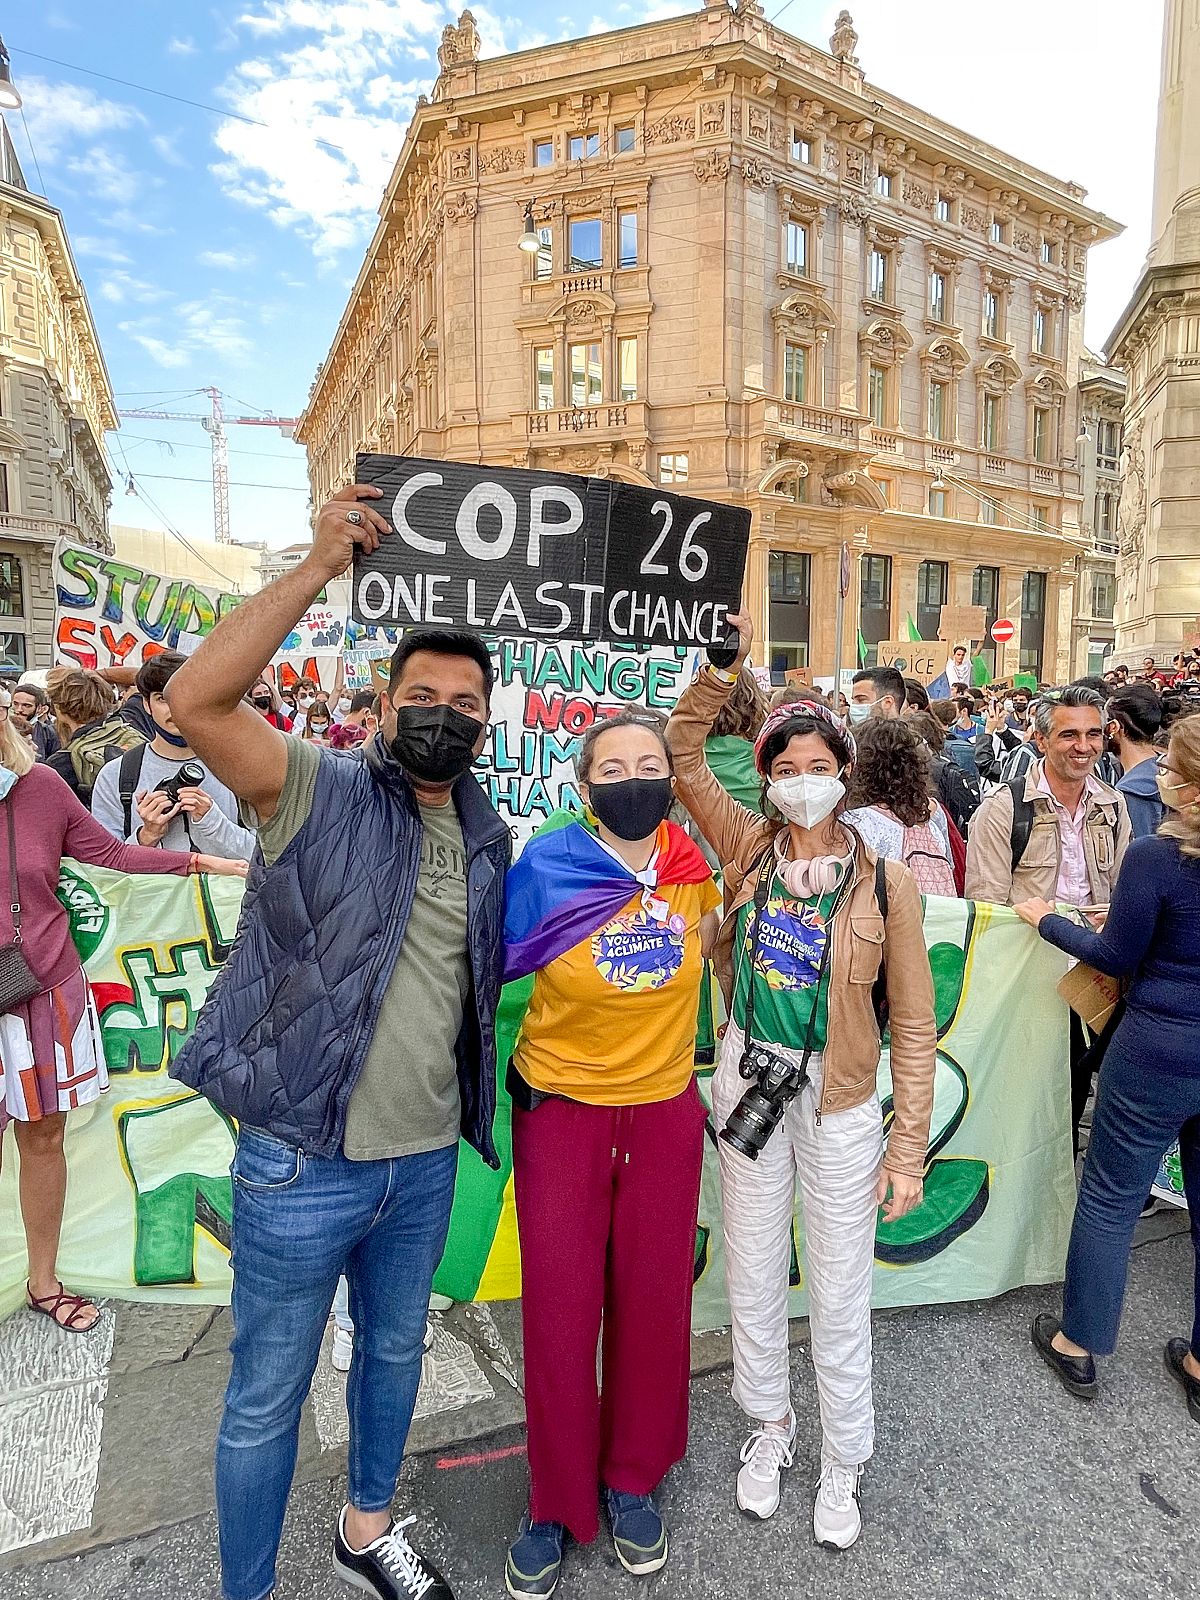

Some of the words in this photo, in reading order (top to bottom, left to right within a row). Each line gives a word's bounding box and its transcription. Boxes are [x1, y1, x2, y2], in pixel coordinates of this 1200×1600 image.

[391, 472, 583, 567] COP
[640, 500, 712, 582] 26
[358, 571, 453, 624] ONE
[467, 579, 604, 634] LAST
[608, 590, 728, 643] CHANCE
[57, 617, 173, 671] SY
[475, 772, 584, 818] HAN
[607, 937, 664, 958] 4CLIMATE
[757, 931, 805, 962] CLIMATE
